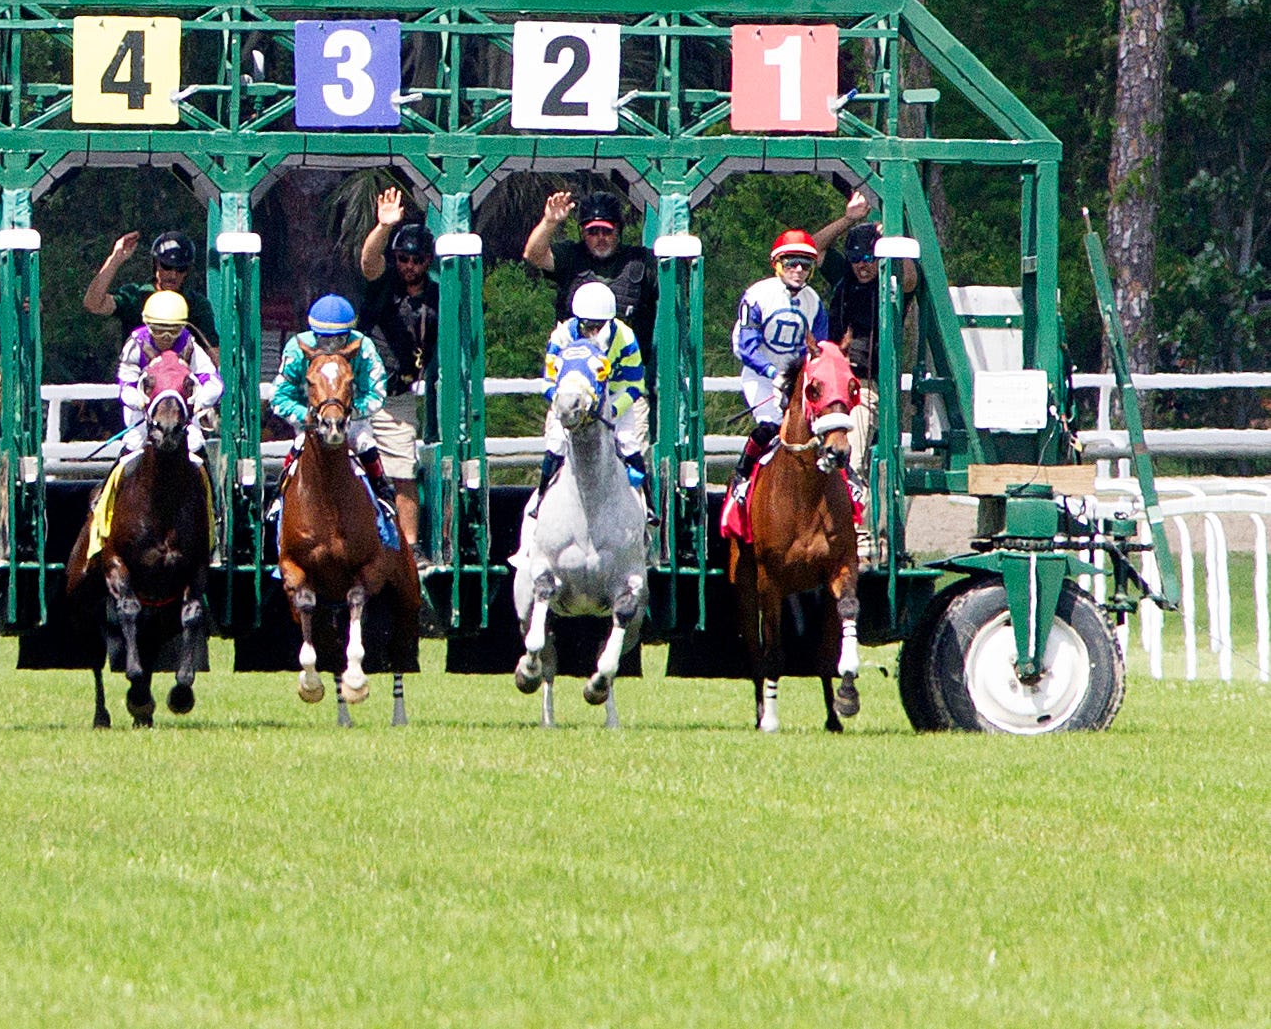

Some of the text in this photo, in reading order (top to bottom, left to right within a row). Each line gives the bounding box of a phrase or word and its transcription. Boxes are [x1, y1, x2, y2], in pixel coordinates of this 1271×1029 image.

[101, 31, 151, 109] 4
[322, 29, 375, 116] 3
[542, 36, 589, 116] 2
[763, 36, 803, 121] 1
